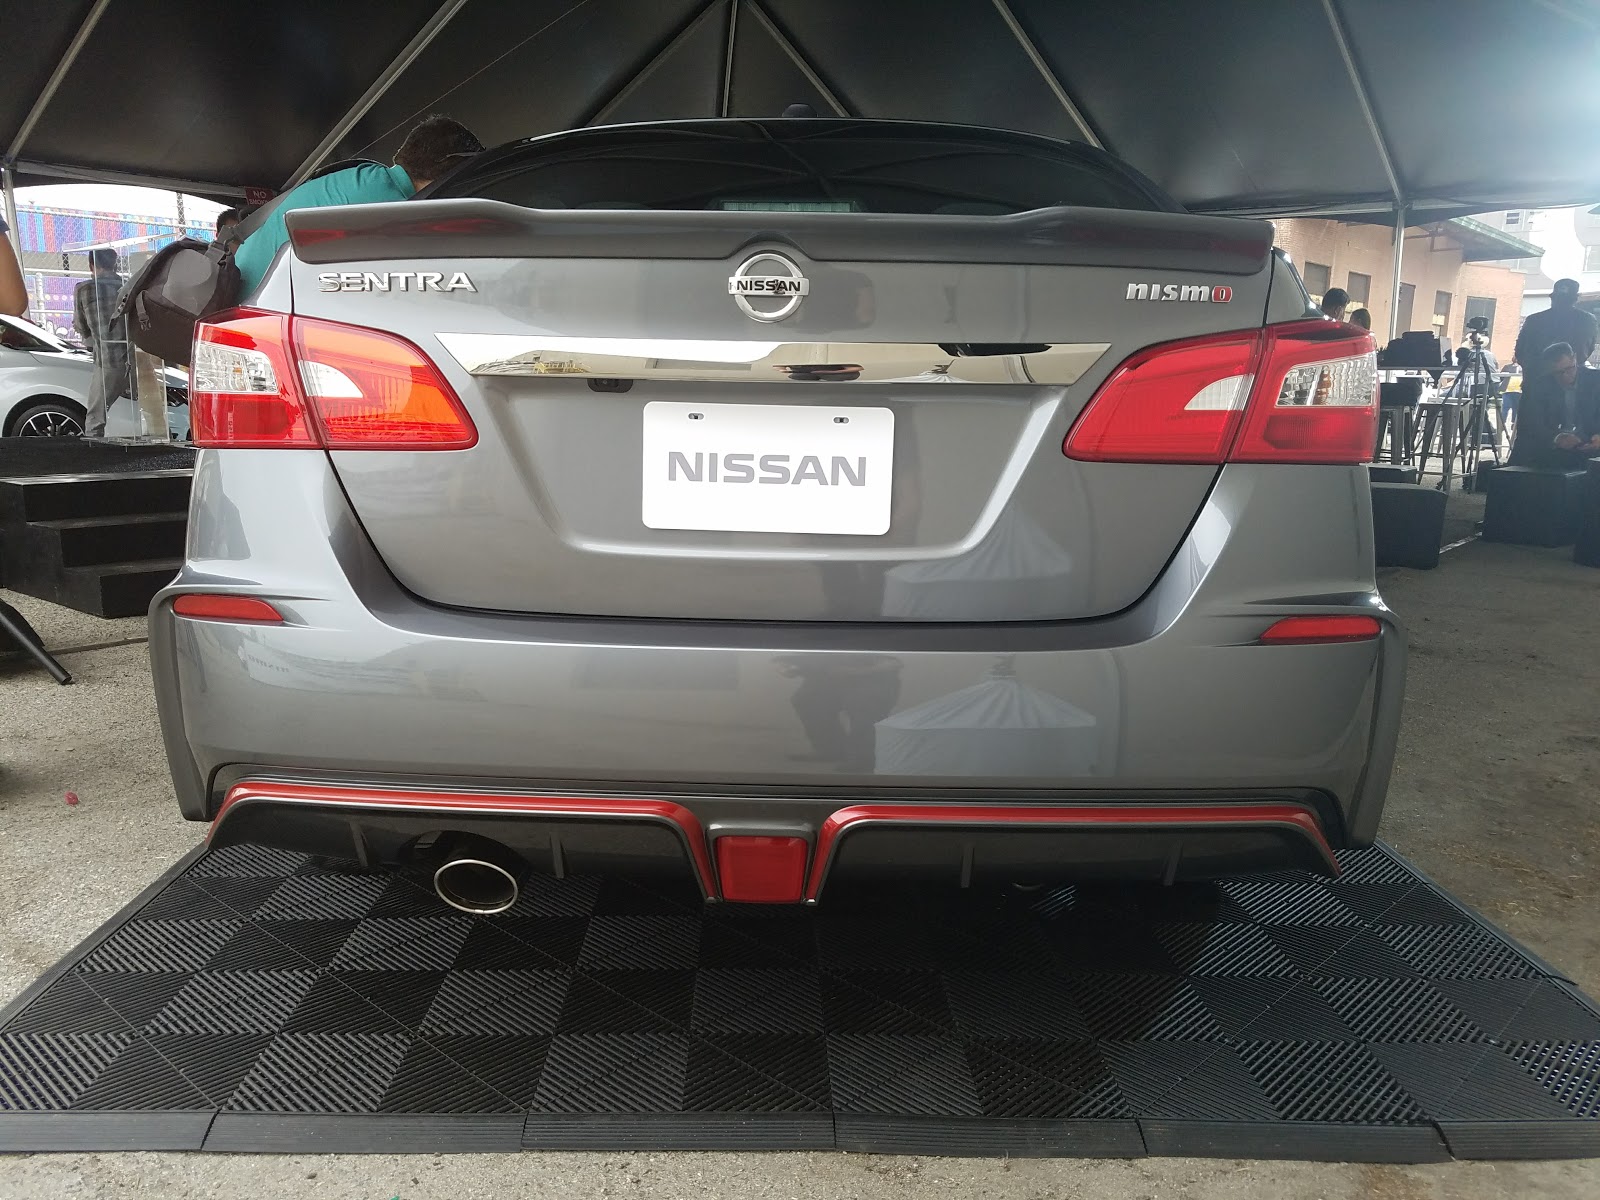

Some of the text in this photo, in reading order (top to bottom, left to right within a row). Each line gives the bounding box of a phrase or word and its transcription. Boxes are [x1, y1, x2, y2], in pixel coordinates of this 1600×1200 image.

[252, 190, 267, 199] NO
[318, 272, 478, 293] SENTRA
[736, 280, 801, 292] NISSAN
[668, 451, 867, 487] NISSAN
